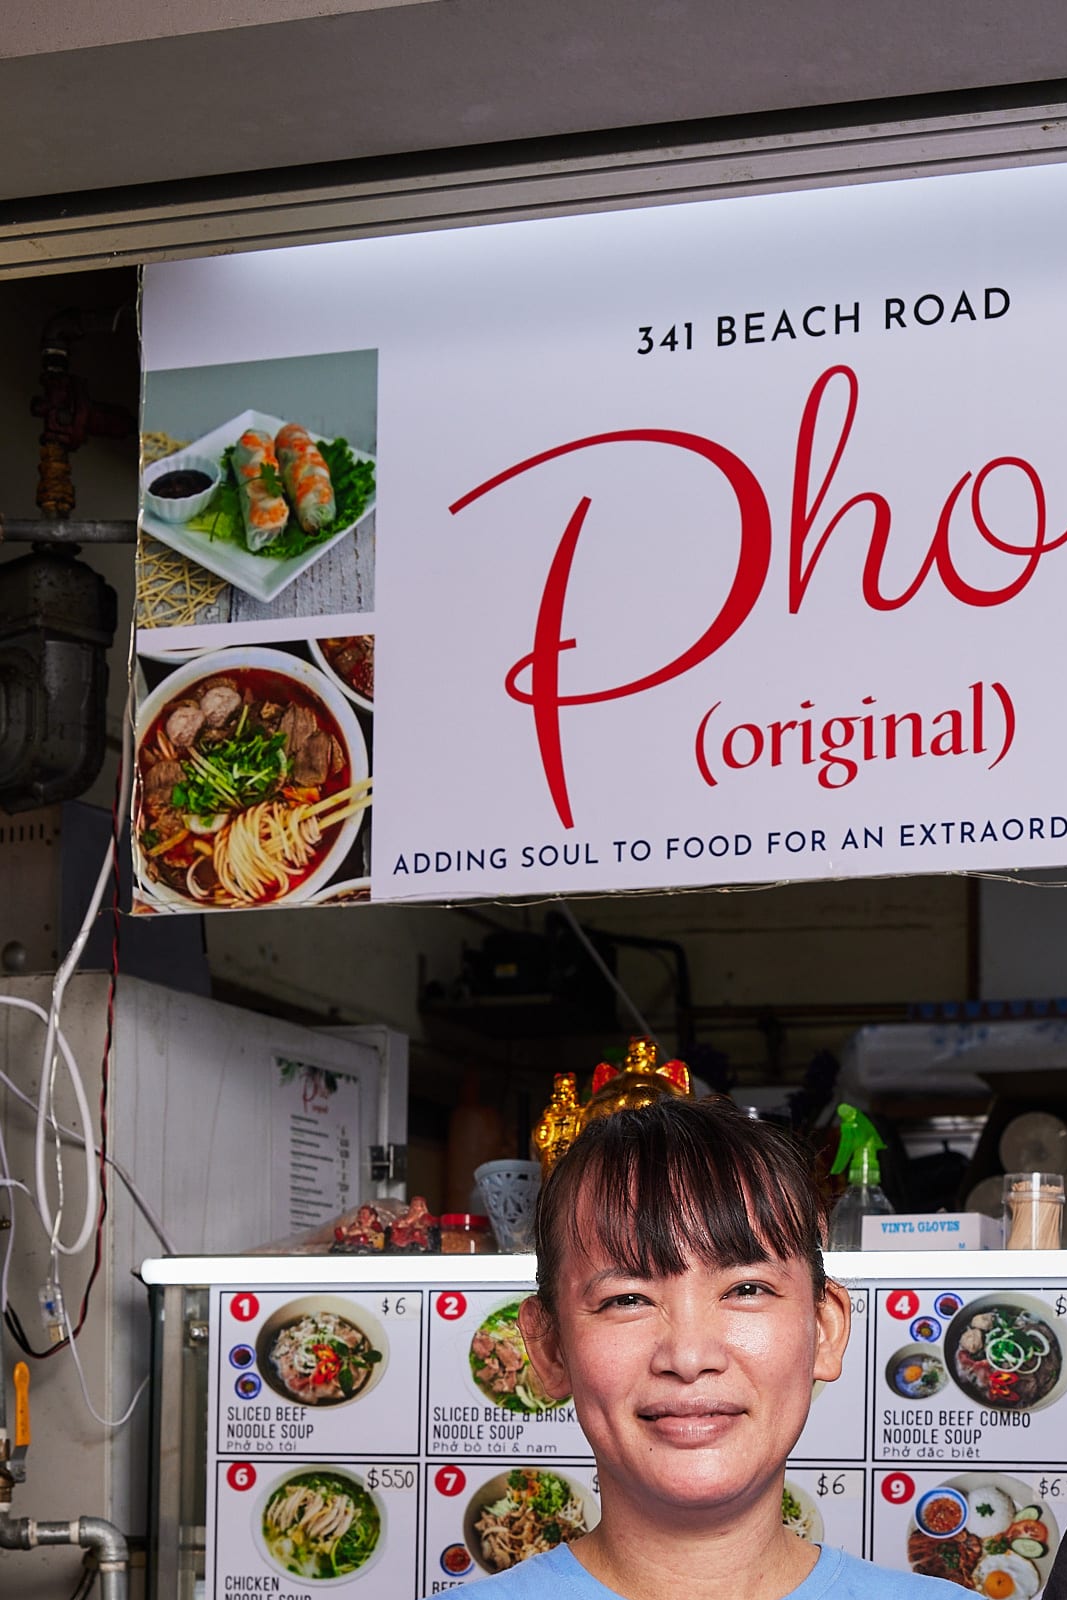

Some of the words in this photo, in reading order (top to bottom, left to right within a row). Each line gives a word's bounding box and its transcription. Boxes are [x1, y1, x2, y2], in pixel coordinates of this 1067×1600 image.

[637, 321, 693, 355] 341
[716, 301, 860, 347] BEACH
[884, 287, 1010, 330] ROAD
[695, 680, 1015, 788] (original)
[393, 848, 507, 875] ADDING
[521, 843, 599, 868] SOUL
[613, 840, 651, 862] TO
[666, 834, 752, 860] FOOD
[768, 830, 826, 854] FOR
[841, 826, 883, 850] AN
[881, 1222, 915, 1233] VINYL
[918, 1220, 960, 1232] GLOVES
[238, 1299, 250, 1317] 1
[444, 1297, 459, 1315] 2
[894, 1295, 911, 1314] 4
[227, 1407, 271, 1421] SLICED
[276, 1407, 308, 1421] BEEF
[433, 1407, 479, 1422] SLICED
[484, 1408, 515, 1422] BEEF
[535, 1408, 578, 1423] BRISK
[883, 1410, 933, 1426] SLICED
[939, 1411, 974, 1426] BEEF
[980, 1412, 1031, 1428] COMBO
[226, 1424, 276, 1439] NOODLE
[281, 1424, 314, 1439] SOUP
[433, 1425, 484, 1440] NOODLE
[489, 1425, 524, 1440] SOUP
[883, 1429, 939, 1444] NOODLE
[945, 1429, 982, 1445] SOUP
[235, 1469, 248, 1485] 6
[443, 1473, 458, 1492] 7
[890, 1479, 906, 1498] 9
[225, 1576, 279, 1591] CHICKEN
